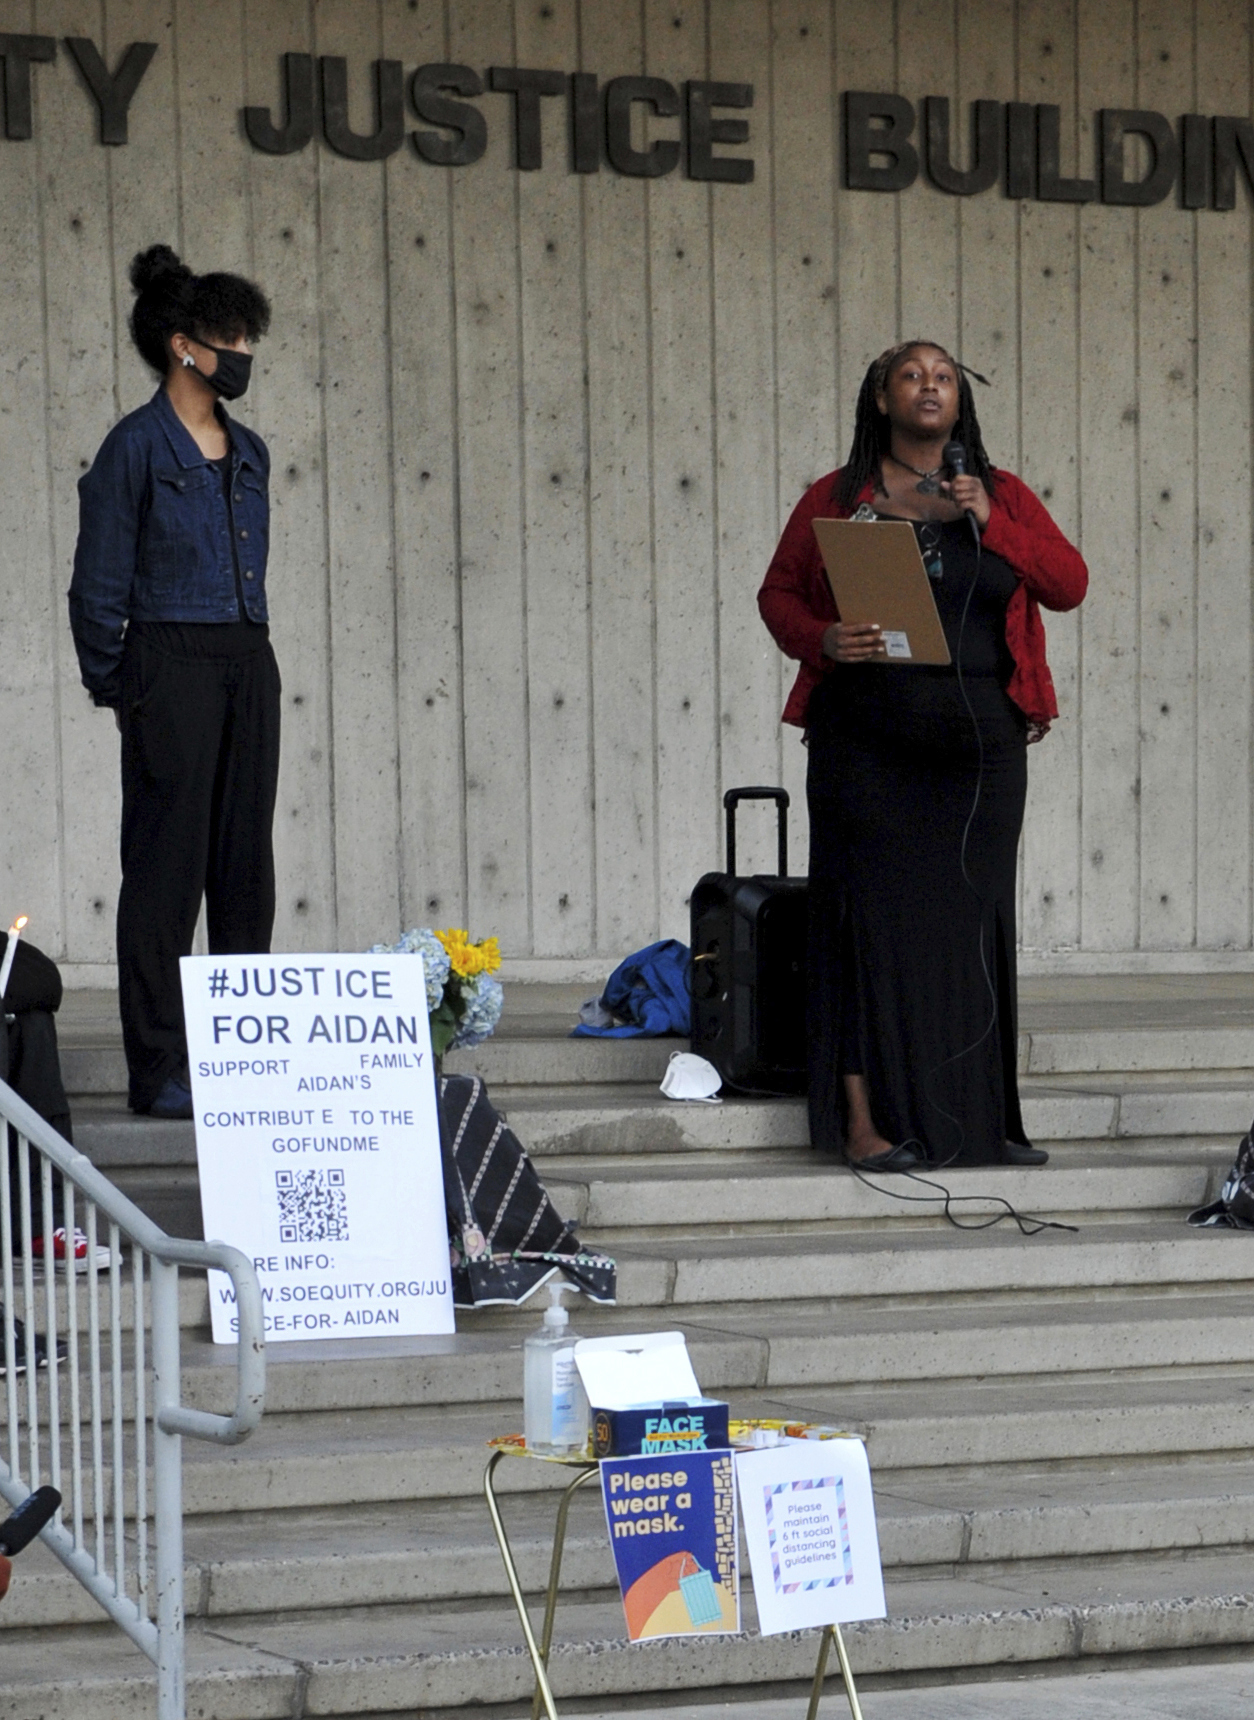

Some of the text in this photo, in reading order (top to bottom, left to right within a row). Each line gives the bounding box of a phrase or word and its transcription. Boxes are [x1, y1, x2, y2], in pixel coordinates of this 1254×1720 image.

[242, 52, 755, 184] JUSTICE
[212, 1014, 418, 1045] FOR AIDAN
[198, 1052, 424, 1092] SUPPORT AIDAN'S FAMILY
[349, 1110, 375, 1126] TO
[379, 1109, 414, 1126] THE
[272, 1136, 380, 1153] GOFUNDME
[285, 1254, 336, 1272] INFO:
[219, 1280, 447, 1305] WW.SOEQUITY.ORG/JU
[344, 1309, 399, 1326] AIDAN
[645, 1415, 705, 1435] FACE
[641, 1433, 709, 1455] MASK
[610, 1470, 688, 1494] Please
[611, 1492, 692, 1516] wear a
[787, 1503, 823, 1515] Please
[614, 1512, 685, 1539] mask.
[783, 1514, 830, 1528] maintain
[782, 1524, 833, 1541] 6 ft social
[782, 1539, 837, 1555] distancing
[784, 1551, 837, 1569] guidelines
